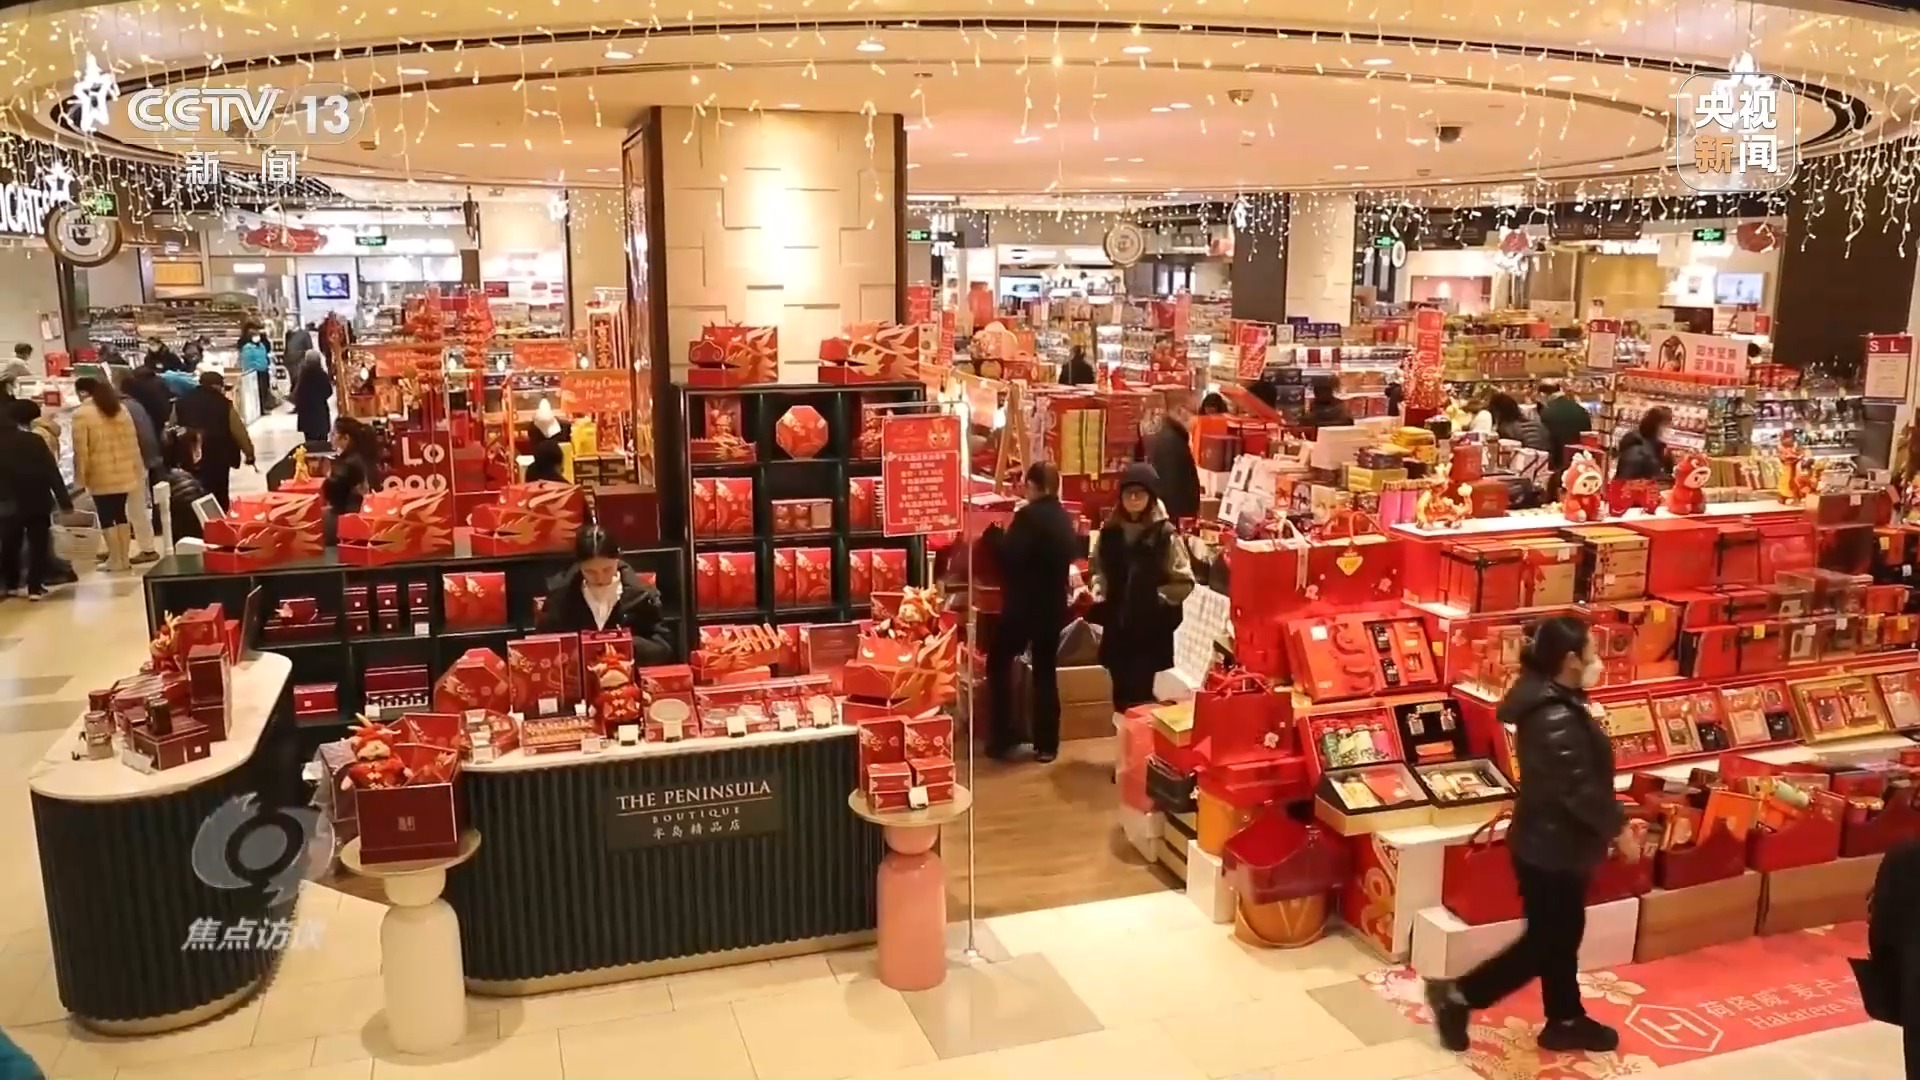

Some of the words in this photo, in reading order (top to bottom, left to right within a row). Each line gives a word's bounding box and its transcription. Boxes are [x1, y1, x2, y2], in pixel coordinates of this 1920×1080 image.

[616, 792, 656, 810] THE
[664, 780, 771, 805] PENINSULA
[652, 806, 740, 823] BOUTIQUE
[653, 819, 740, 840] 半岛精品店
[1745, 1002, 1845, 1030] Hakatere
